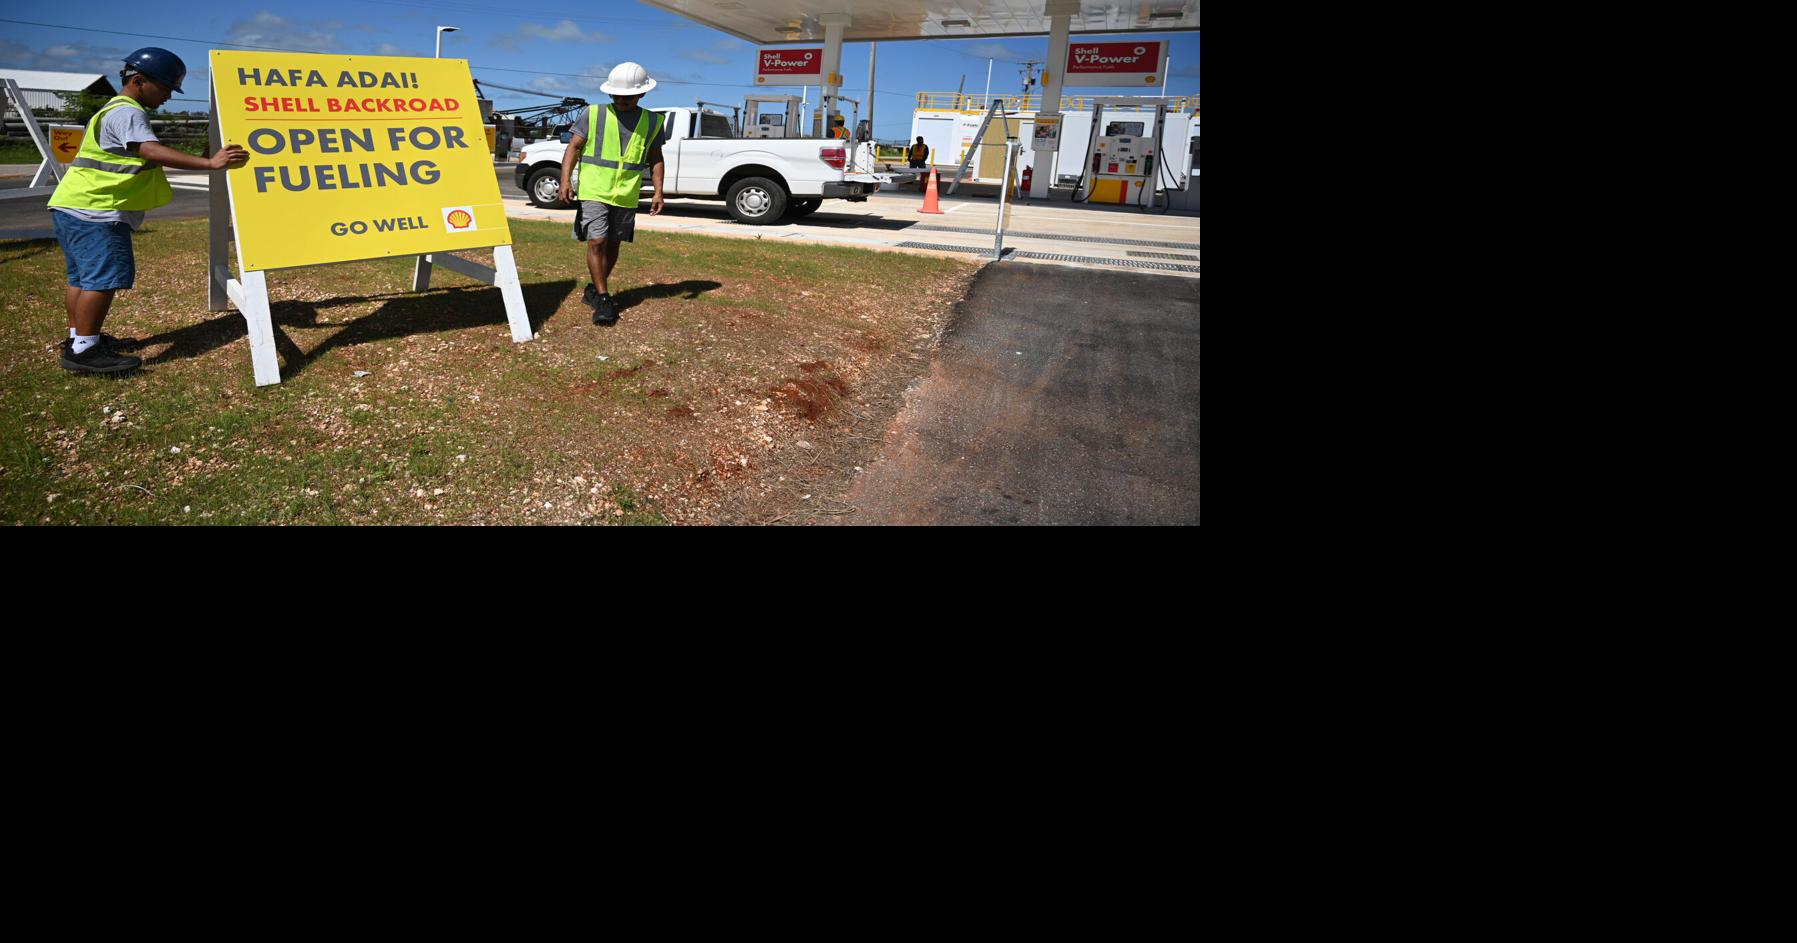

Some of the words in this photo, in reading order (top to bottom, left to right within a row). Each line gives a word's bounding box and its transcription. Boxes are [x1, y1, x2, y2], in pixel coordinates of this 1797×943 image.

[1074, 55, 1140, 64] V-Power
[237, 67, 328, 88] HAFA
[336, 70, 419, 89] ADAI!
[244, 96, 321, 113] SHELL
[326, 97, 460, 113] BACKROAD
[247, 127, 375, 155] OPEN
[387, 126, 469, 151] FOR
[253, 160, 441, 193] FUELING
[330, 220, 368, 237] GO
[372, 216, 429, 233] WELL
